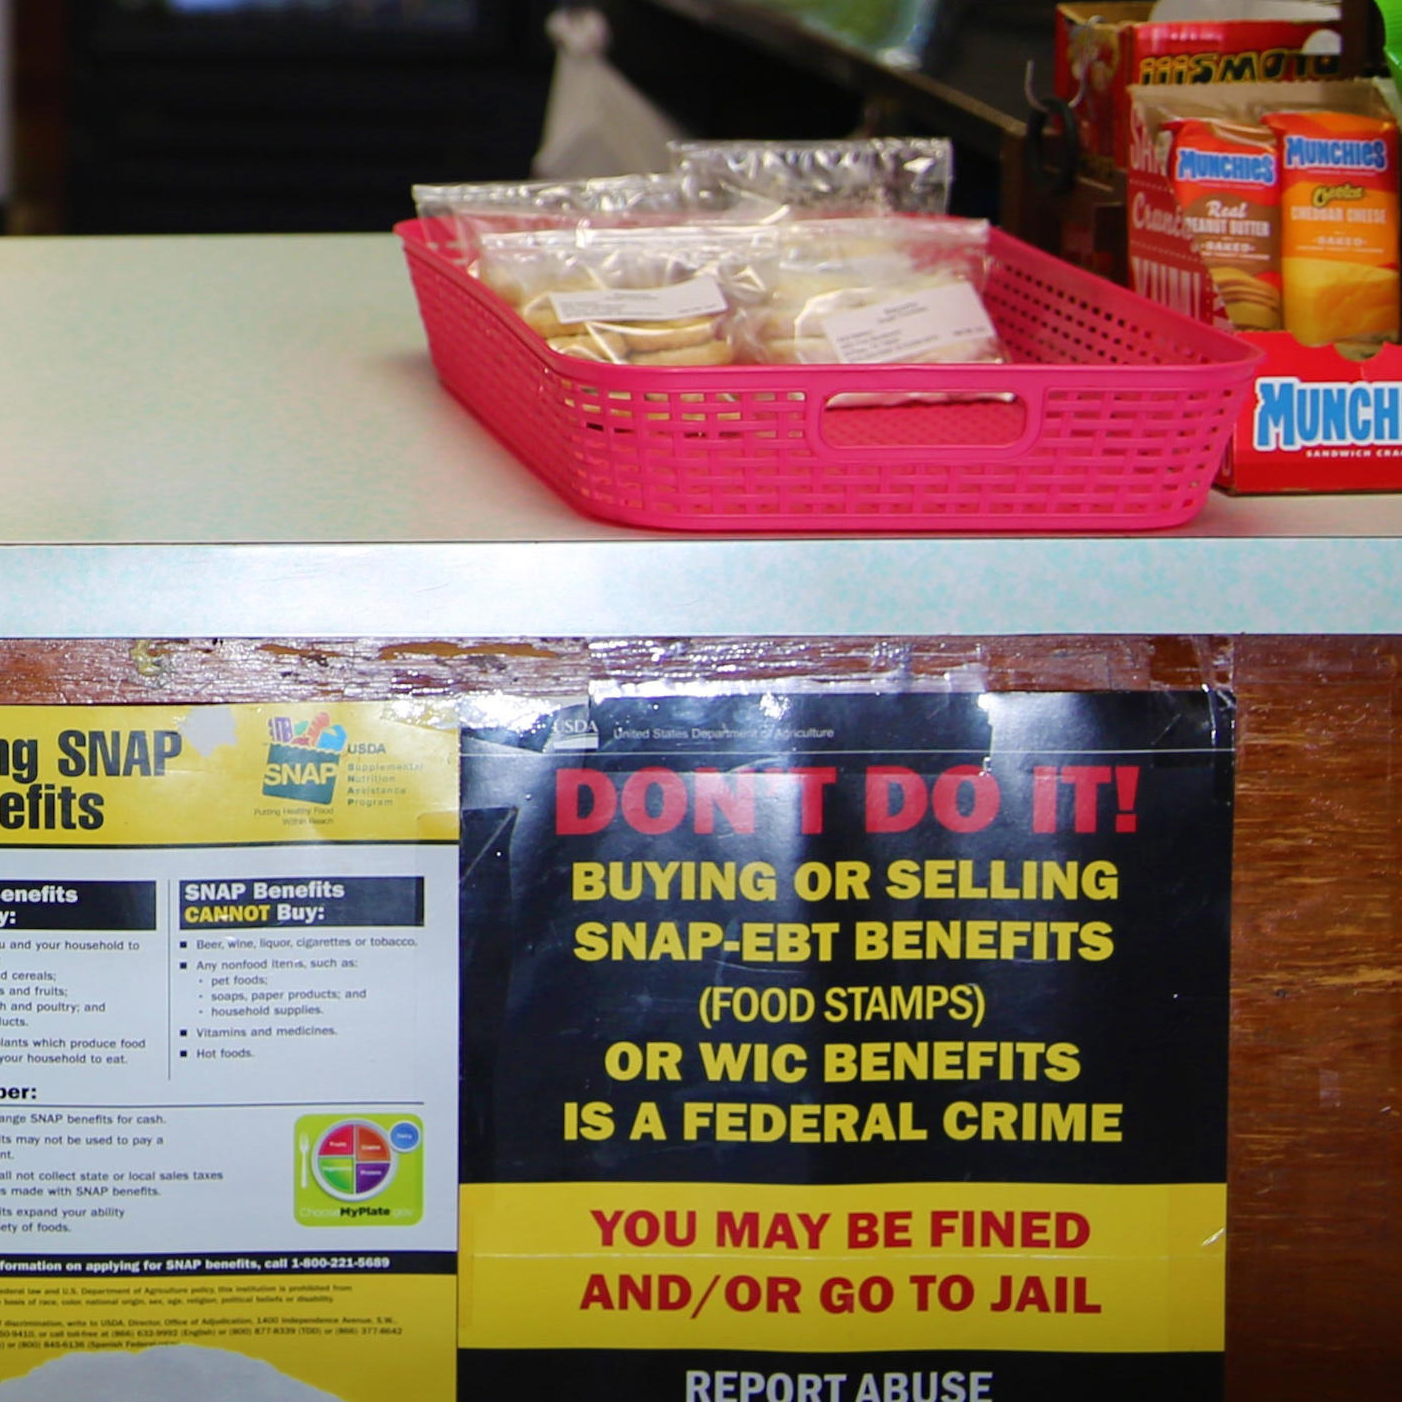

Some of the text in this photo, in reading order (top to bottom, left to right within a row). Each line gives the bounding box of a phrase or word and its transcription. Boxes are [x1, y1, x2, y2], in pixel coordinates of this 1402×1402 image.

[1206, 200, 1248, 218] Real
[1230, 219, 1270, 237] BUTTER
[1253, 377, 1402, 451] MUNCH
[1306, 450, 1371, 458] SANDWICH
[613, 728, 650, 740] United
[653, 729, 689, 740] States
[692, 728, 757, 741] Department
[776, 727, 834, 740] Agriculture
[58, 730, 182, 777] SNAP
[347, 743, 387, 755] USDA
[264, 762, 339, 786] SNAP
[347, 775, 395, 783] Nutrition
[347, 787, 407, 795] Assistance
[556, 764, 1140, 835] DON'T DO IT!
[347, 798, 393, 807] Program
[573, 860, 1118, 901] BUYING OR SELLING
[185, 881, 344, 901] SNAP Benefits
[185, 904, 324, 923] CANNOT Buy:
[10, 940, 31, 949] and
[36, 942, 60, 951] your
[65, 940, 124, 950] household
[128, 942, 139, 950] to
[197, 940, 224, 949] Beer,
[228, 940, 256, 948] wine,
[260, 938, 292, 949] liquor,
[296, 938, 351, 949] cigarettes
[370, 937, 417, 946] tobacco.
[574, 921, 1114, 961] SNAP-EBT BENEFITS
[12, 971, 56, 981] cereals;
[211, 975, 267, 987] pet foods;
[9, 987, 30, 995] and
[35, 986, 67, 997] fruits;
[700, 983, 985, 1029] (FOOD STAMPS)
[196, 1026, 337, 1038] Vitamins and medicines.
[605, 1042, 1080, 1083] OR WIC BENEFITS
[31, 1114, 63, 1123] SNAP
[67, 1115, 113, 1124] benefits
[117, 1115, 132, 1124] for
[137, 1115, 165, 1124] cash.
[564, 1101, 1123, 1142] IS A FEDERAL CRIME
[590, 1210, 1090, 1250] YOU MAY BE FINED
[66, 1263, 82, 1271] on
[86, 1260, 140, 1272] applying
[143, 1260, 162, 1270] for
[166, 1259, 201, 1270] SNAP
[205, 1258, 261, 1270] benefits,
[264, 1258, 287, 1268] call
[580, 1274, 1101, 1319] AND/OR GO TO JAIL
[686, 1371, 993, 1402] REPORT ABUSE
